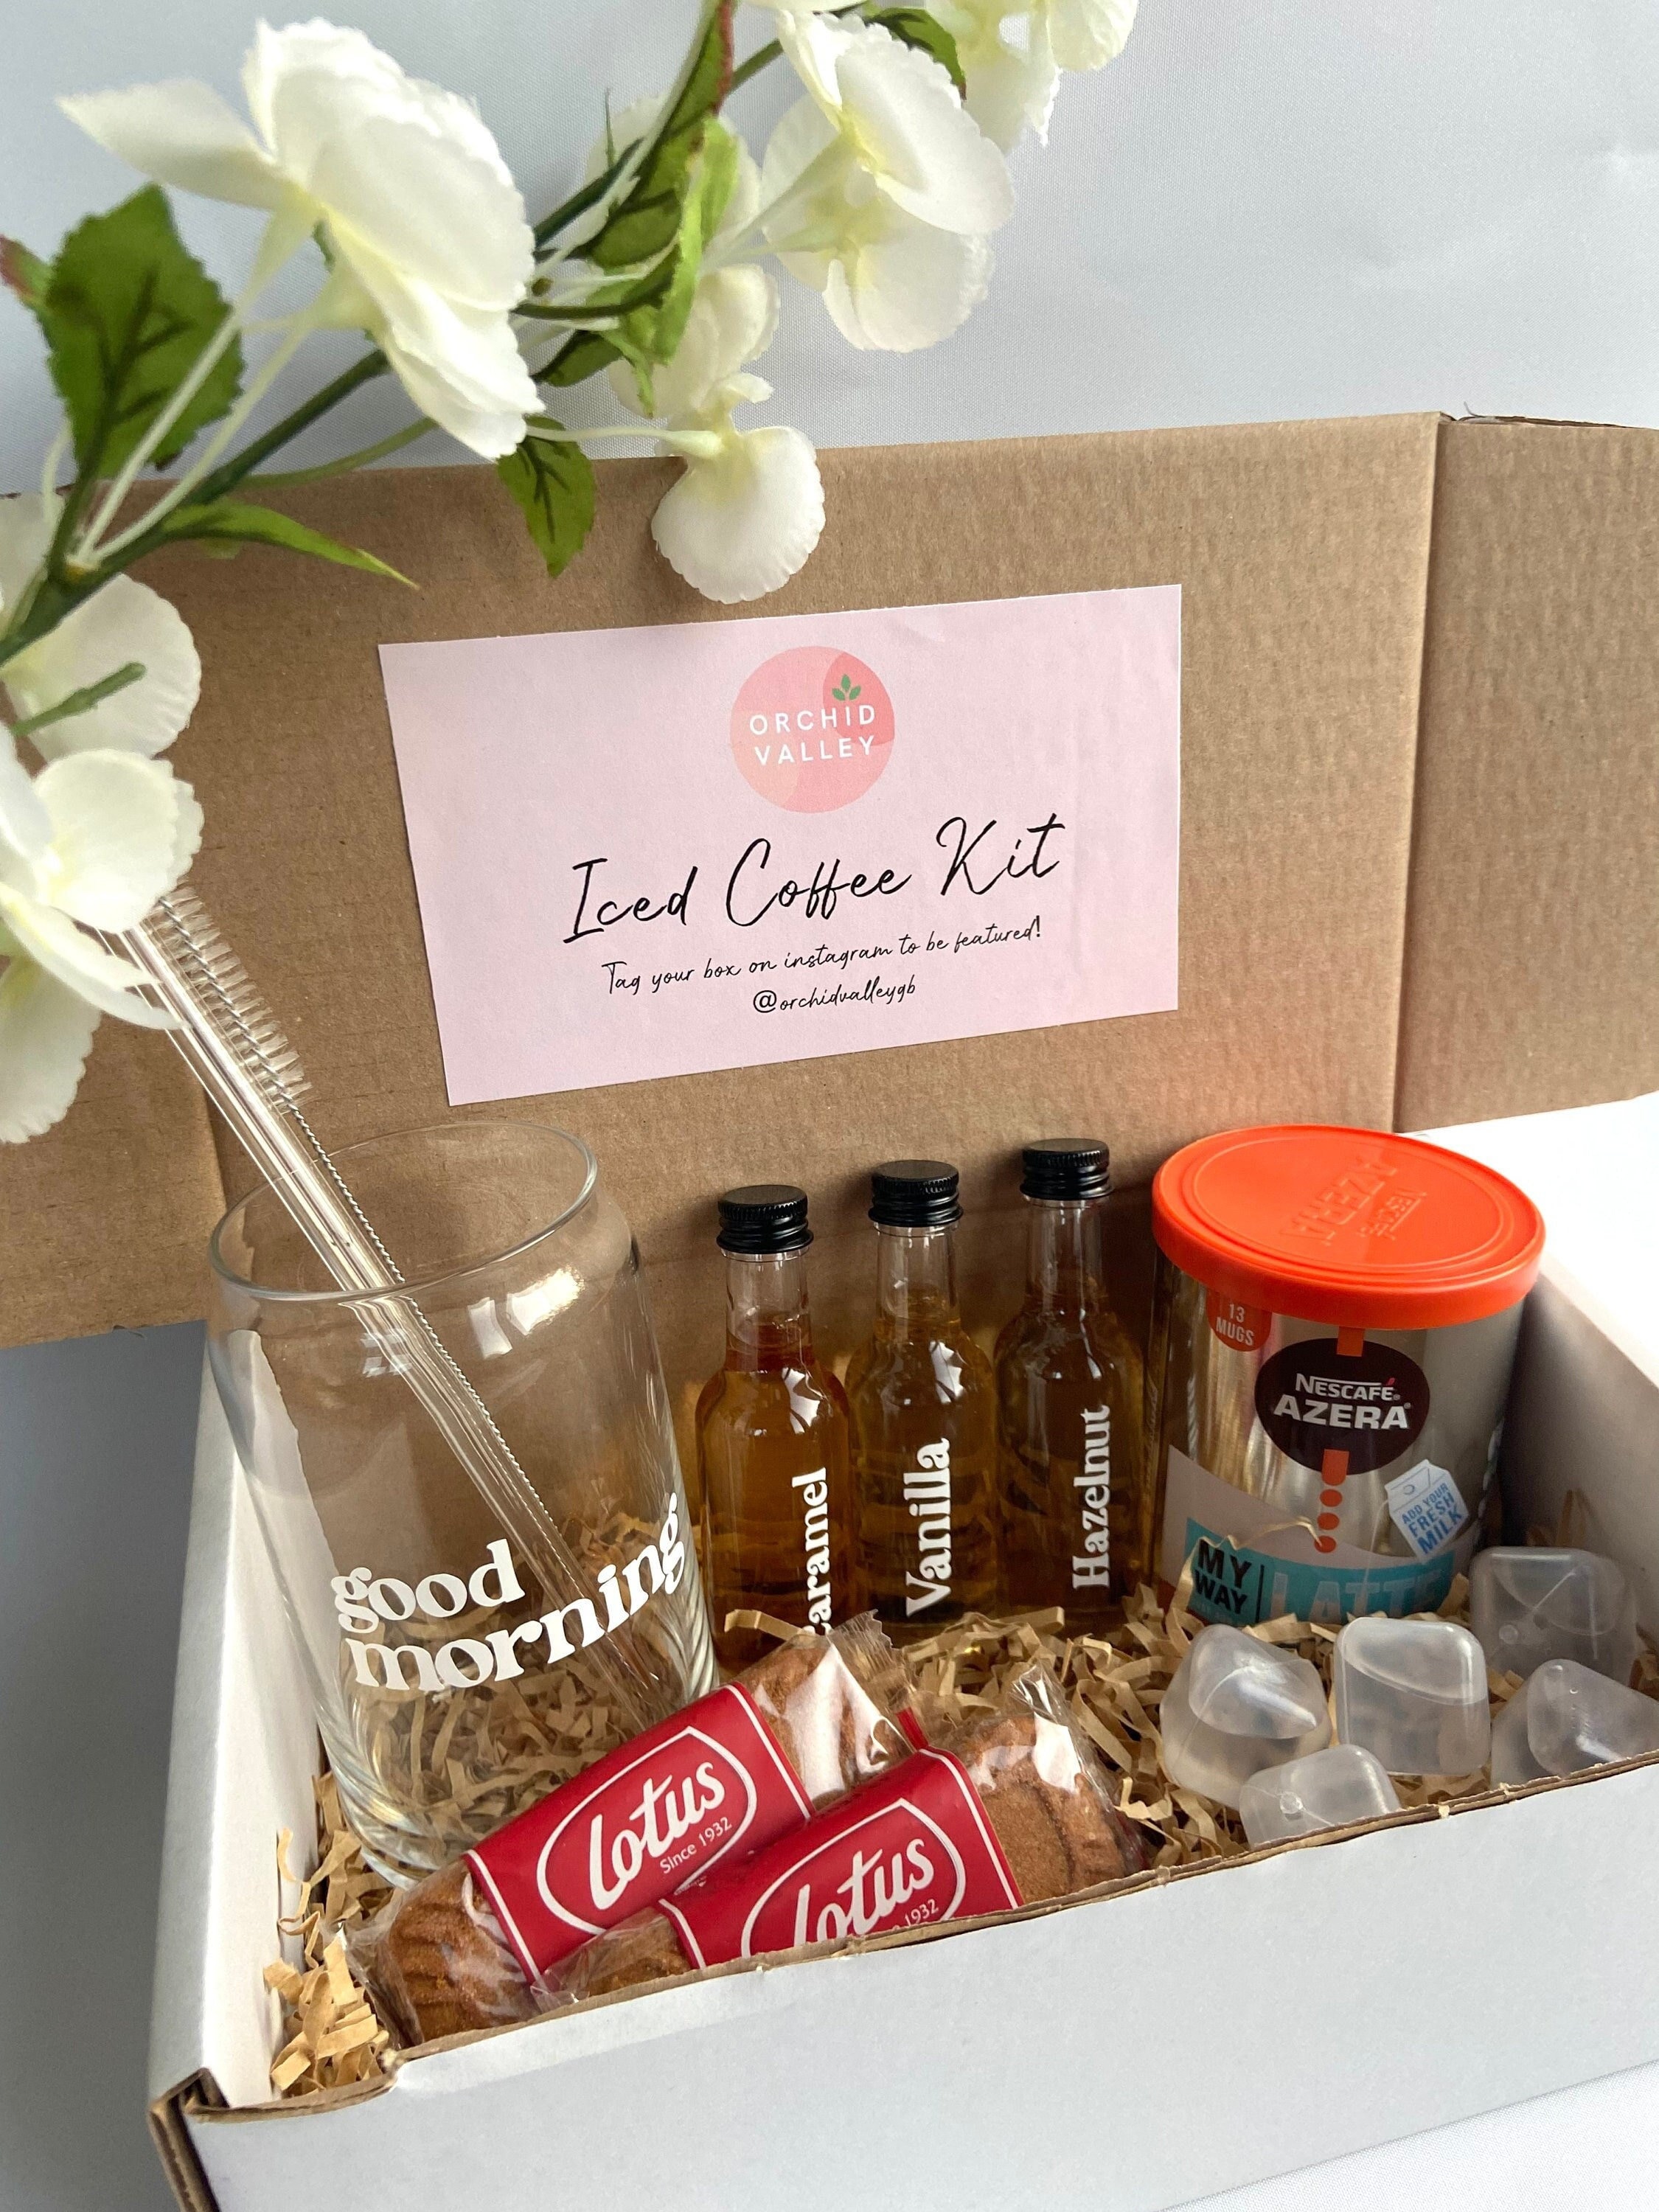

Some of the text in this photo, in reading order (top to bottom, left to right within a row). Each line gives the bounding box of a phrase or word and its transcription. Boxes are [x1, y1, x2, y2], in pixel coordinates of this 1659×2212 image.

[749, 704, 875, 735] ORCHID
[754, 735, 874, 765] VALLEY
[563, 813, 1065, 944] Iced Coffee Kit
[601, 915, 1041, 995] Tag your box on instagram to be featured!
[753, 974, 916, 1013] @orchidvalleygb
[1216, 1316, 1254, 1346] MUGS
[1230, 1304, 1245, 1323] 13
[1273, 1394, 1408, 1430] AZERA
[1072, 1405, 1110, 1589] Hazelnut
[1402, 1483, 1448, 1524] ADD YOUR
[1408, 1492, 1455, 1538] FRESH
[903, 1438, 952, 1617] Vanilla
[1417, 1505, 1462, 1554] MILK
[330, 1539, 525, 1634] good
[1197, 1539, 1251, 1589] MY
[345, 1492, 685, 1691] morning
[1193, 1569, 1248, 1615] WAY
[660, 1817, 732, 1874] Since 1932
[904, 1899, 939, 1927] 1932
